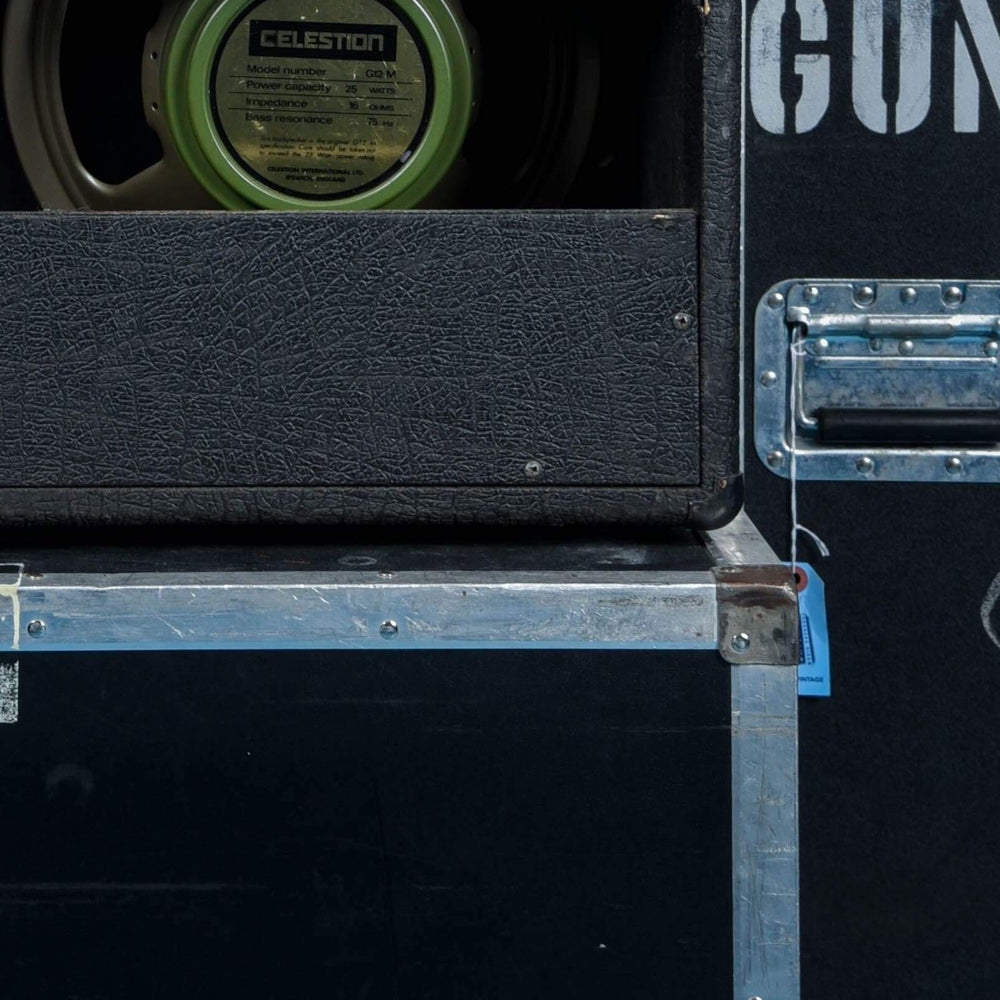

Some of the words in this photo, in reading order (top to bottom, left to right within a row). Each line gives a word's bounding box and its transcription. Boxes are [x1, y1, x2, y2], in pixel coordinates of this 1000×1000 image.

[260, 29, 384, 51] CELESTION
[247, 65, 280, 74] Model
[283, 66, 327, 76] number
[386, 70, 396, 79] M
[246, 80, 281, 90] Power
[284, 81, 331, 93] capacity
[345, 85, 357, 94] 25
[369, 87, 395, 95] WATTS
[246, 98, 308, 109] Impedance
[349, 102, 359, 110] 16
[245, 112, 272, 122] Bass
[275, 115, 332, 125] resonance
[368, 117, 378, 126] 75
